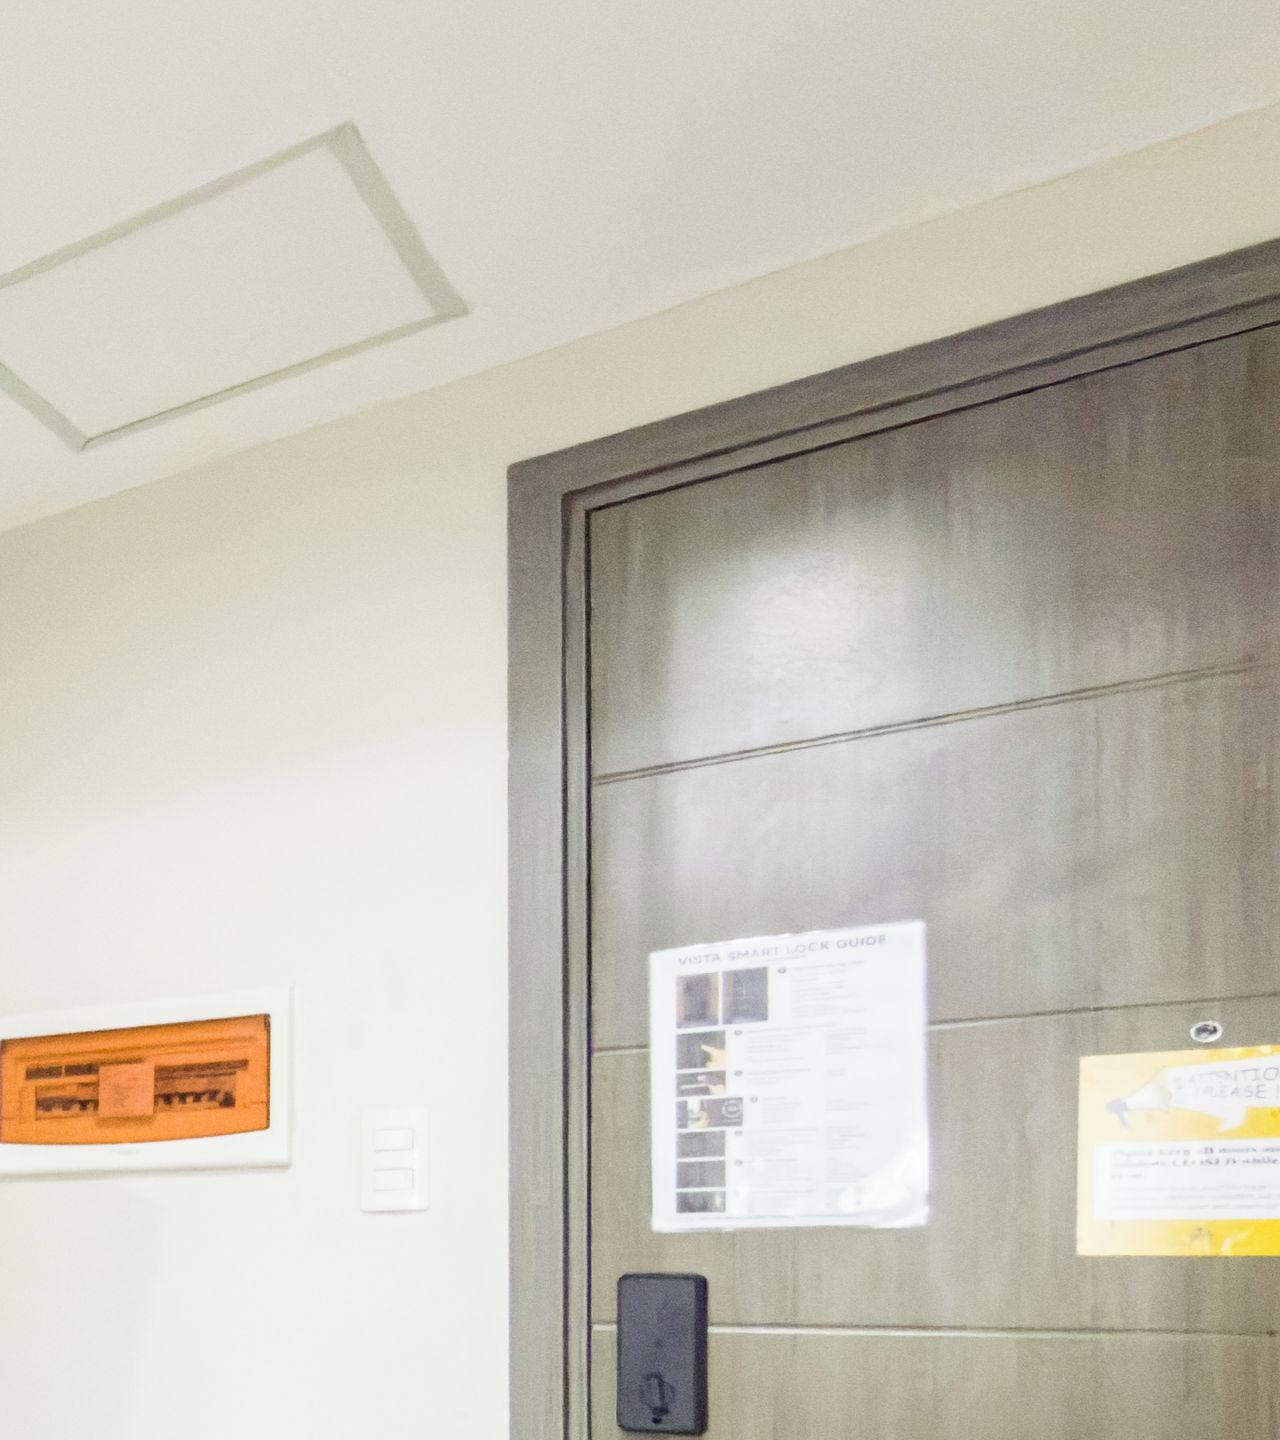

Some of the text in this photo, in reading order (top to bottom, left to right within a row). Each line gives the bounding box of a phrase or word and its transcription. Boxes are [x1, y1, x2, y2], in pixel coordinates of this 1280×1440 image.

[678, 952, 721, 966] VISTA
[727, 945, 780, 961] SMART
[786, 941, 830, 955] LOCK
[836, 934, 887, 949] GUIDE
